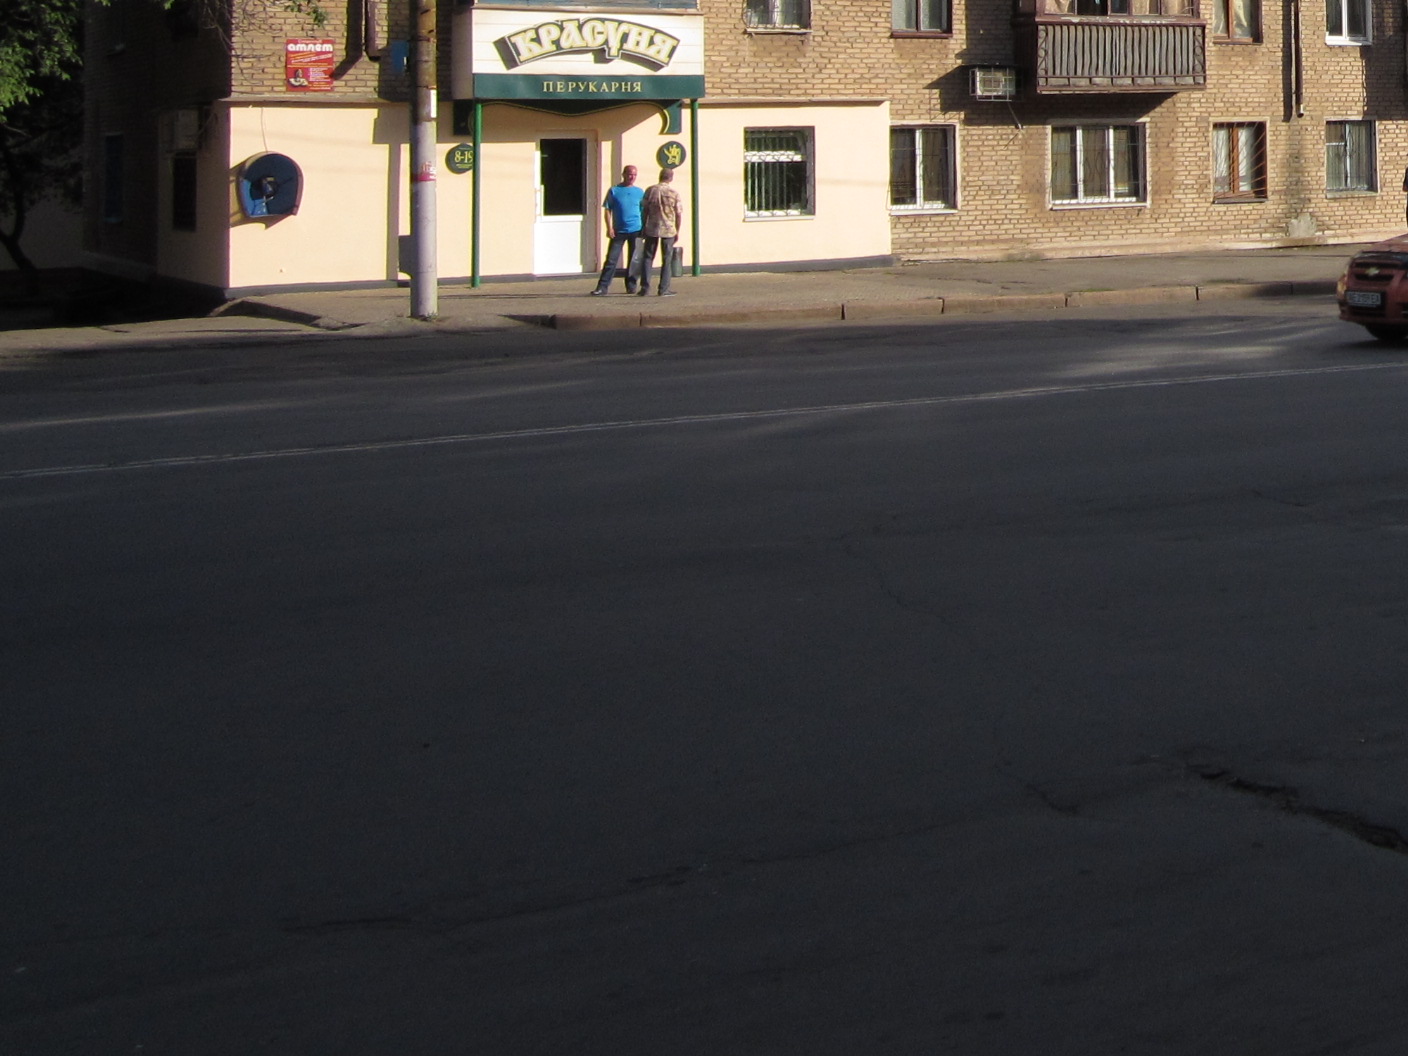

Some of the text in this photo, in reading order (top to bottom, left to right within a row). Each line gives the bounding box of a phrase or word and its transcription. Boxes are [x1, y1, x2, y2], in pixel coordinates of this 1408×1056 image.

[510, 18, 680, 63] КРАСУНЯ
[543, 81, 642, 93] ПЕРУКАРНЯ
[454, 150, 474, 163] 8-19
